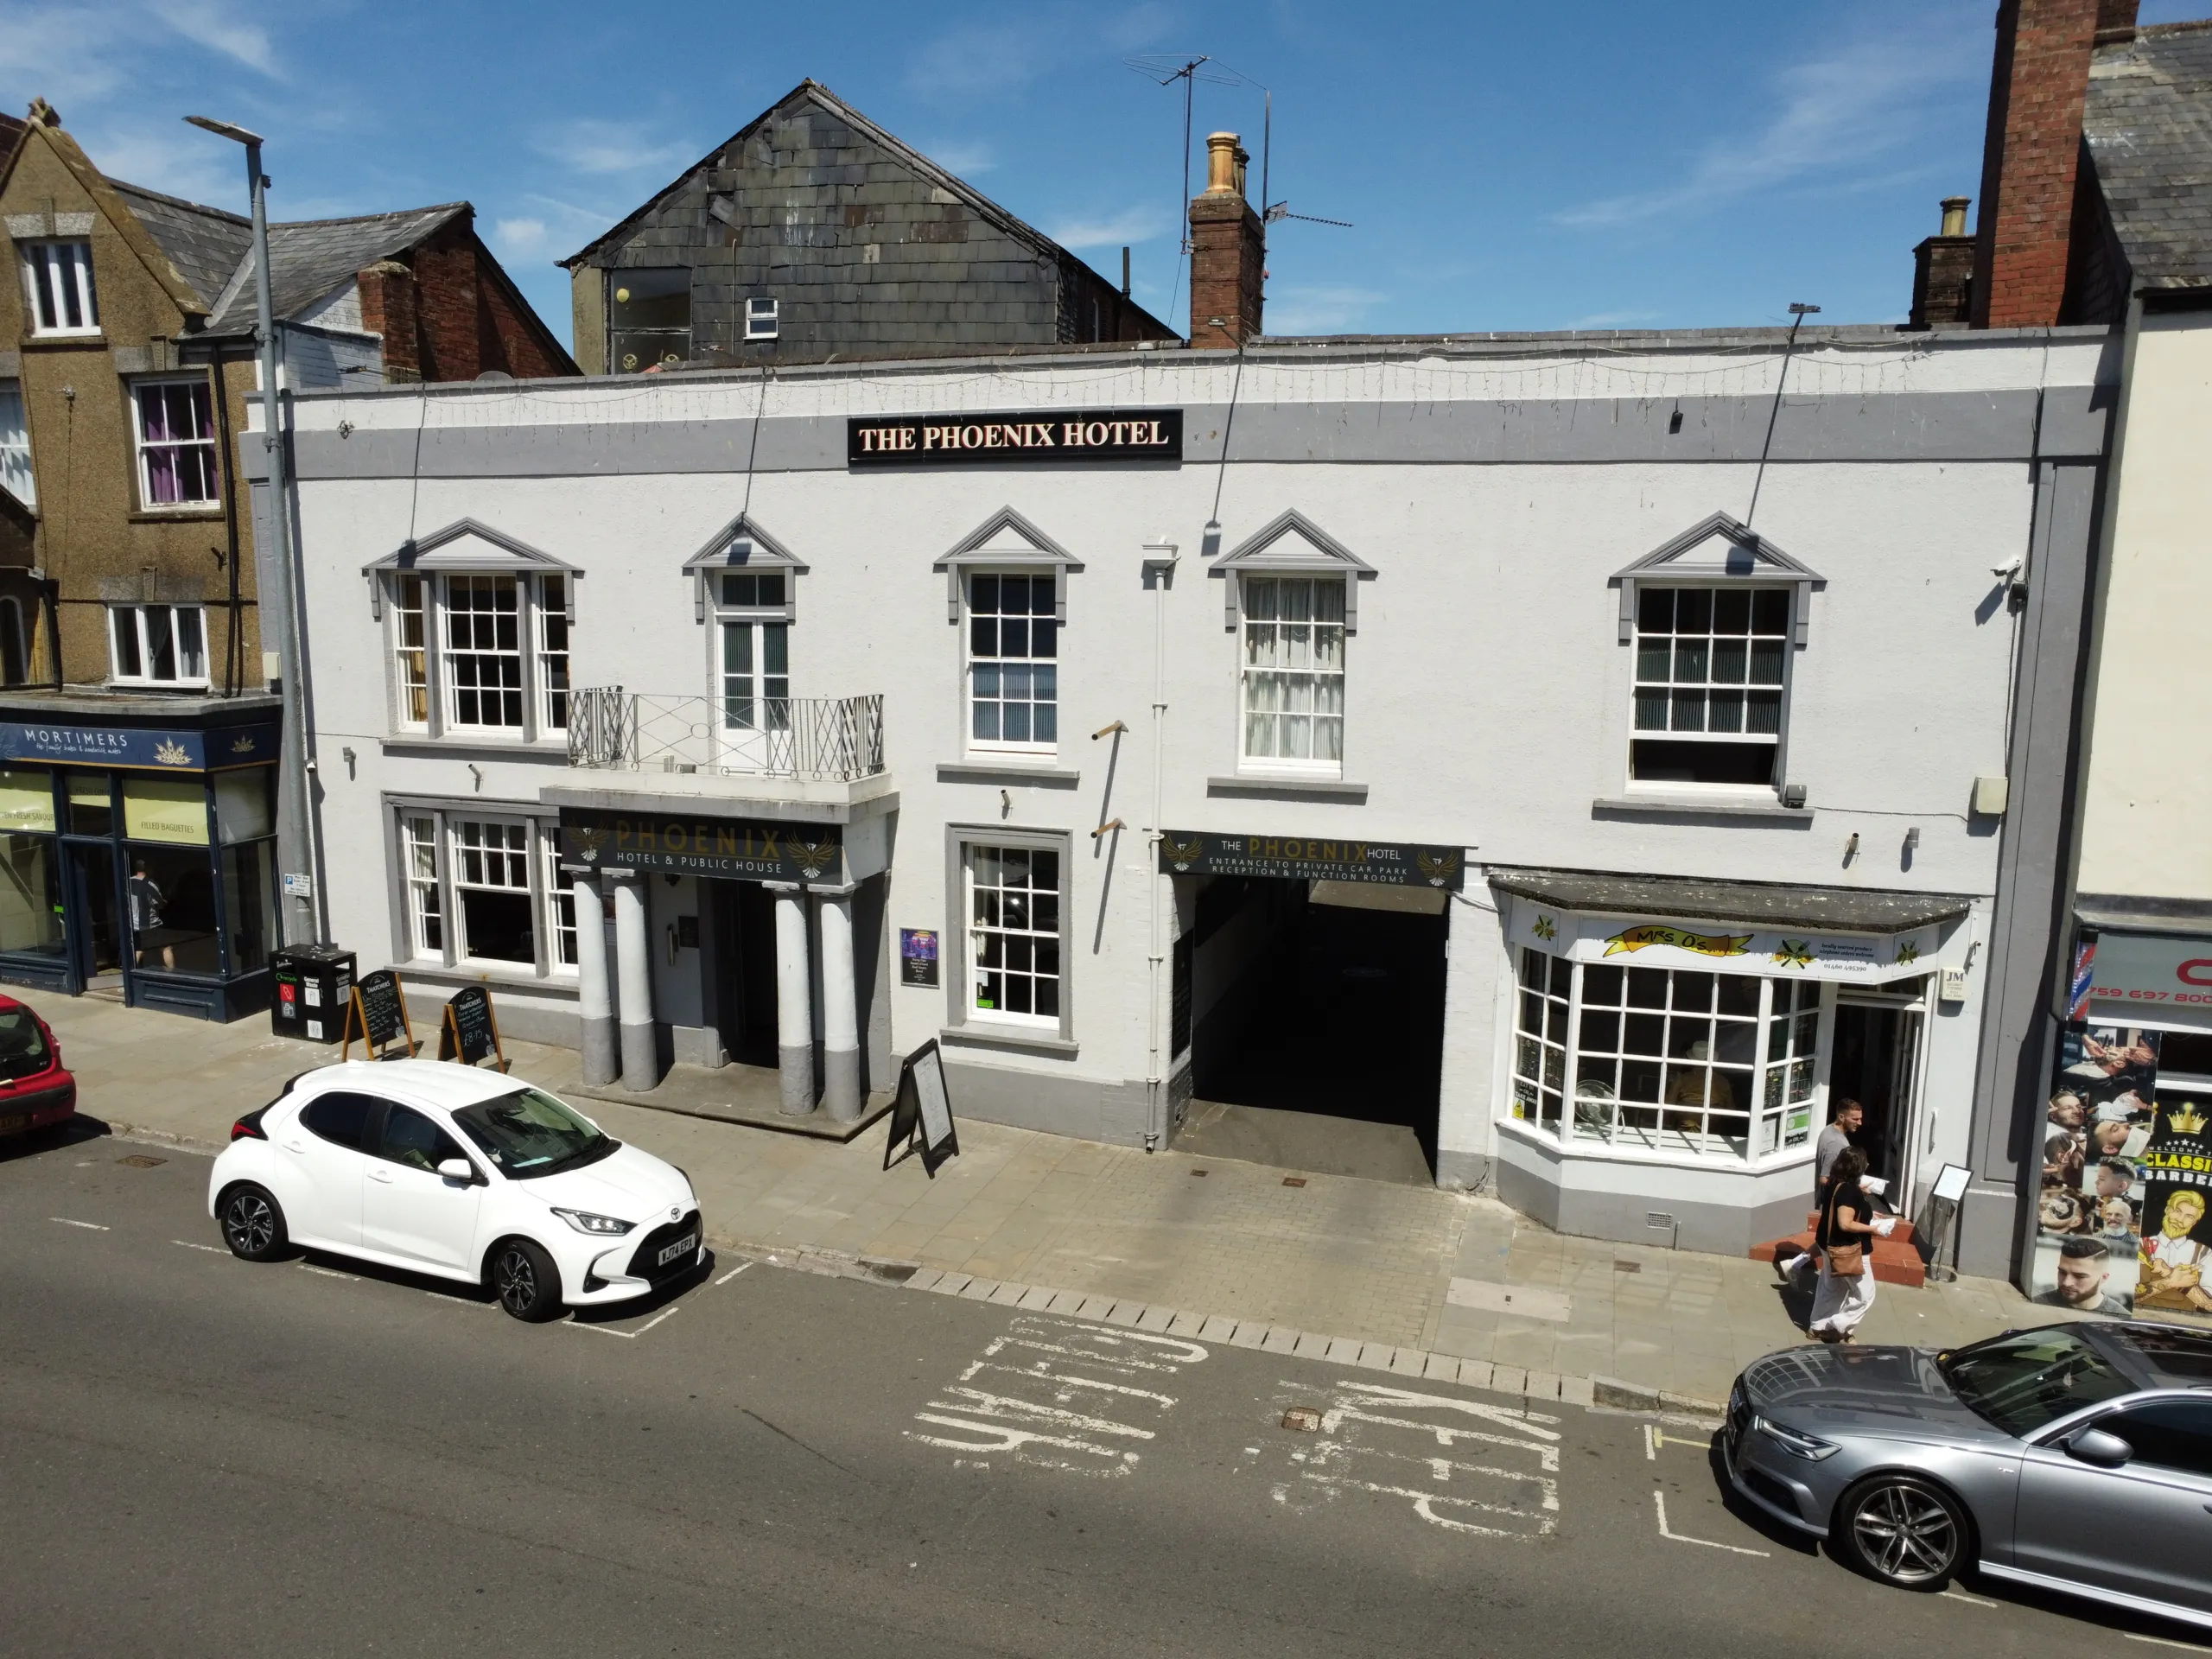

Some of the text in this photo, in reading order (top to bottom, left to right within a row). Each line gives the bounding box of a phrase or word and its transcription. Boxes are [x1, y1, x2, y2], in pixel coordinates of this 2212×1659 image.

[859, 421, 1169, 452] THE PHOENIX HOTEL
[24, 729, 128, 747] MORTIMERS
[161, 823, 194, 833] BAGUETTES
[616, 820, 780, 858] PHOENIX
[1222, 837, 1401, 862] THE PHOENIX HOTEL
[617, 852, 782, 874] HOTEL & PUBLIC HOUSE
[1209, 857, 1268, 868] ENTRANCE
[1296, 861, 1344, 873] PRIVATE
[1351, 865, 1372, 874] CAR
[1379, 867, 1408, 875] PARK
[1212, 866, 1277, 876] RECEPTION
[1297, 870, 1359, 880] FUNCTION
[1363, 874, 1404, 884] ROOMS
[1946, 972, 1964, 982] JM
[366, 981, 391, 994] THATCHERS
[2129, 990, 2170, 1001] 697
[460, 997, 482, 1011] THATCHERS
[2149, 1146, 2200, 1154] WELCOME
